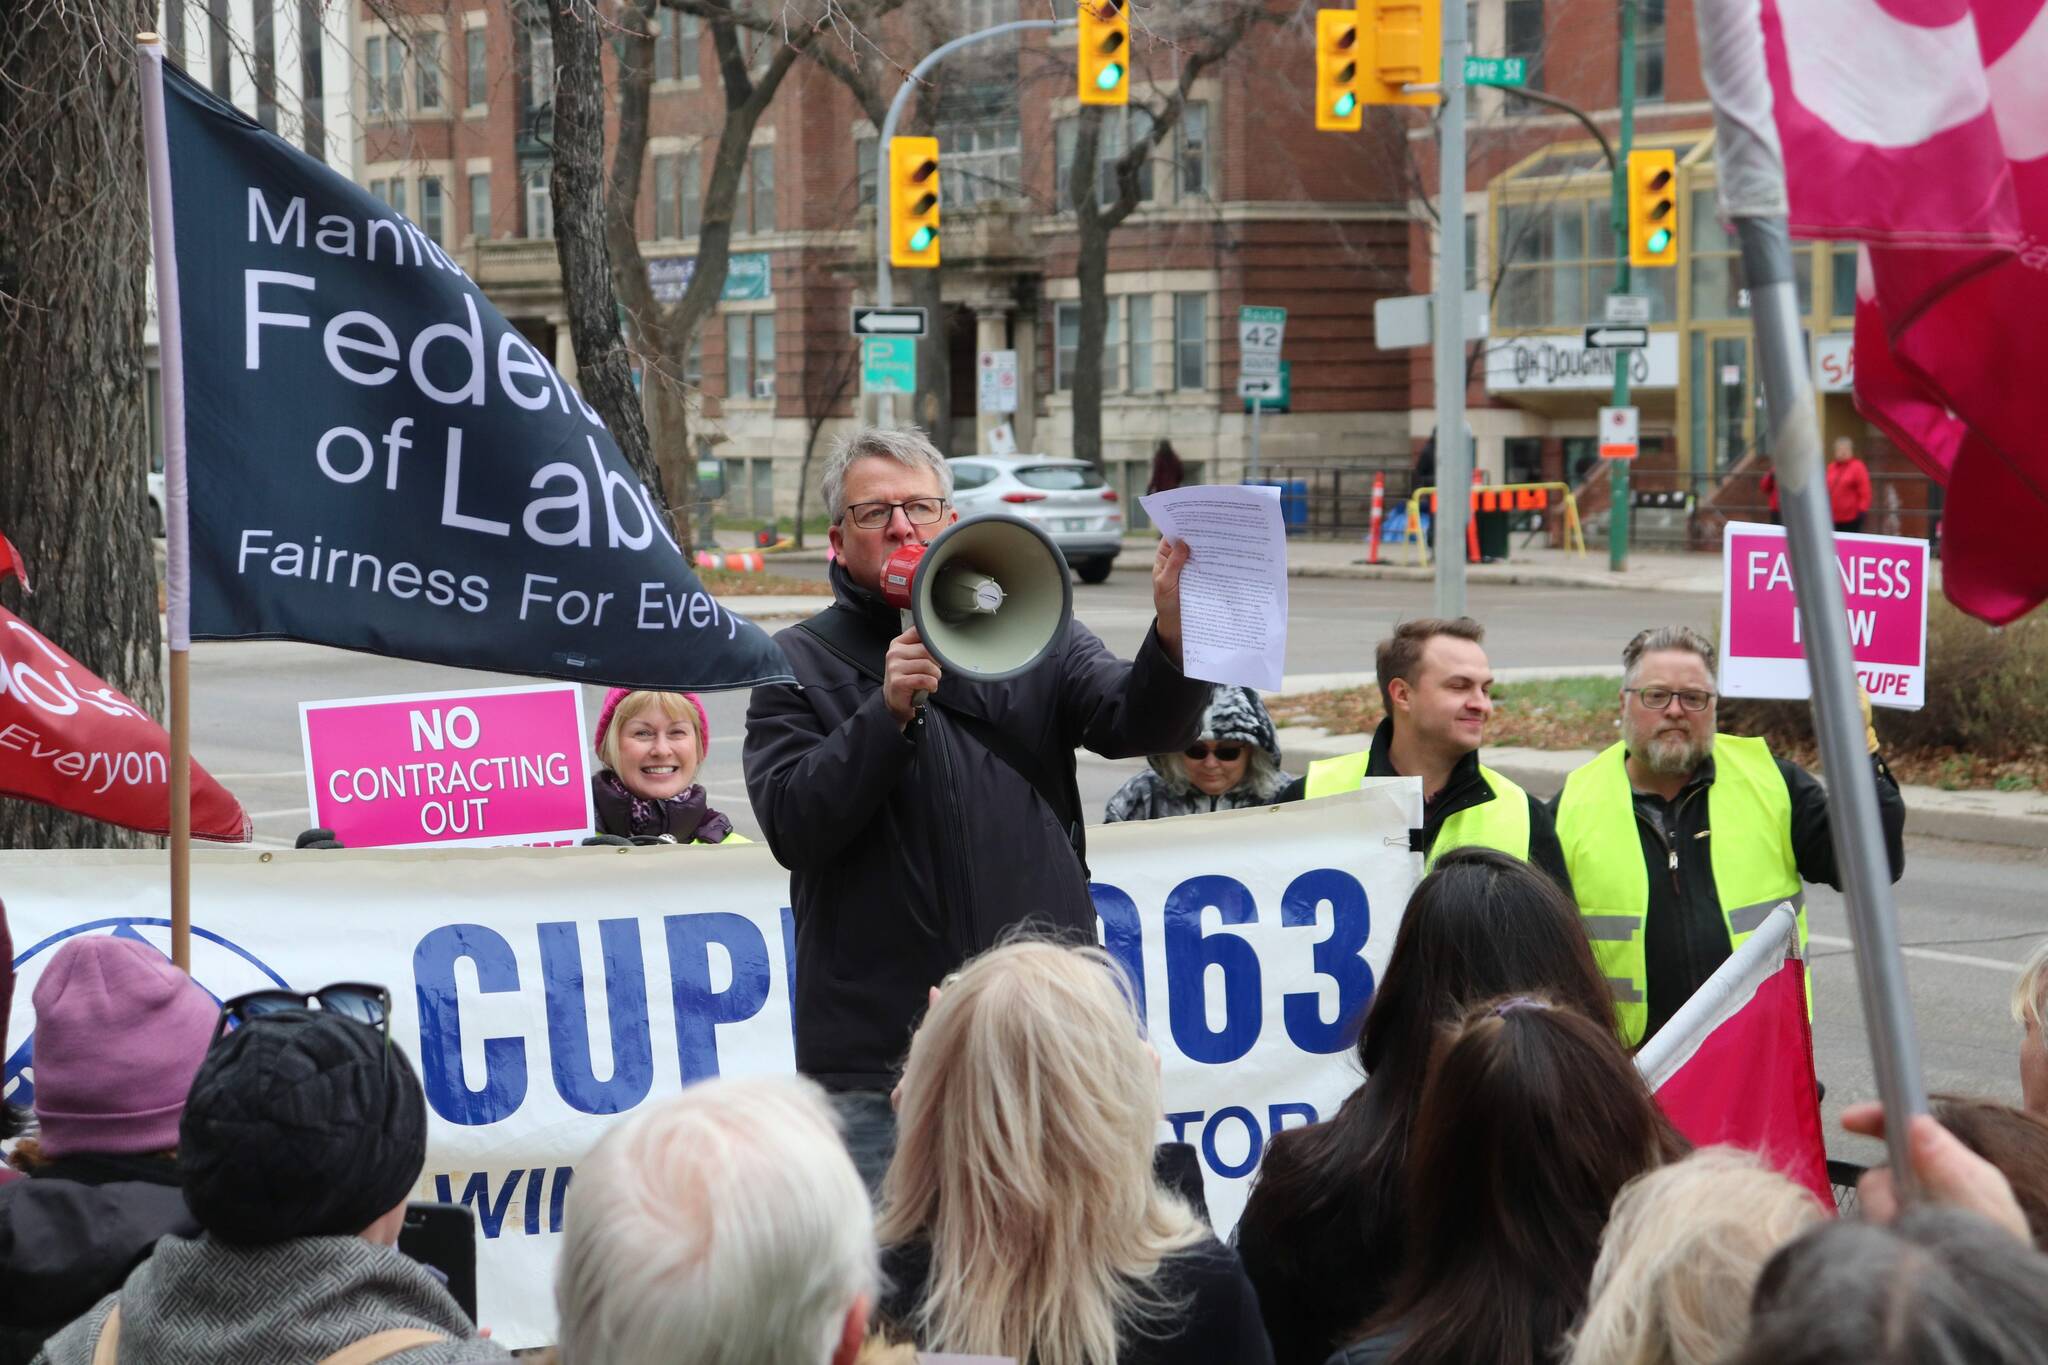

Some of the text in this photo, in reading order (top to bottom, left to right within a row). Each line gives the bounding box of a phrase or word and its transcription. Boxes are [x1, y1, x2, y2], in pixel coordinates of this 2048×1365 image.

[1245, 326, 1278, 347] 42
[316, 417, 414, 490] of
[237, 529, 490, 613] Fairness
[519, 573, 614, 626] For
[1747, 551, 1911, 600] FANESS
[409, 706, 480, 752] NO
[328, 752, 570, 803] CONTRACTING
[420, 798, 489, 836] OUT
